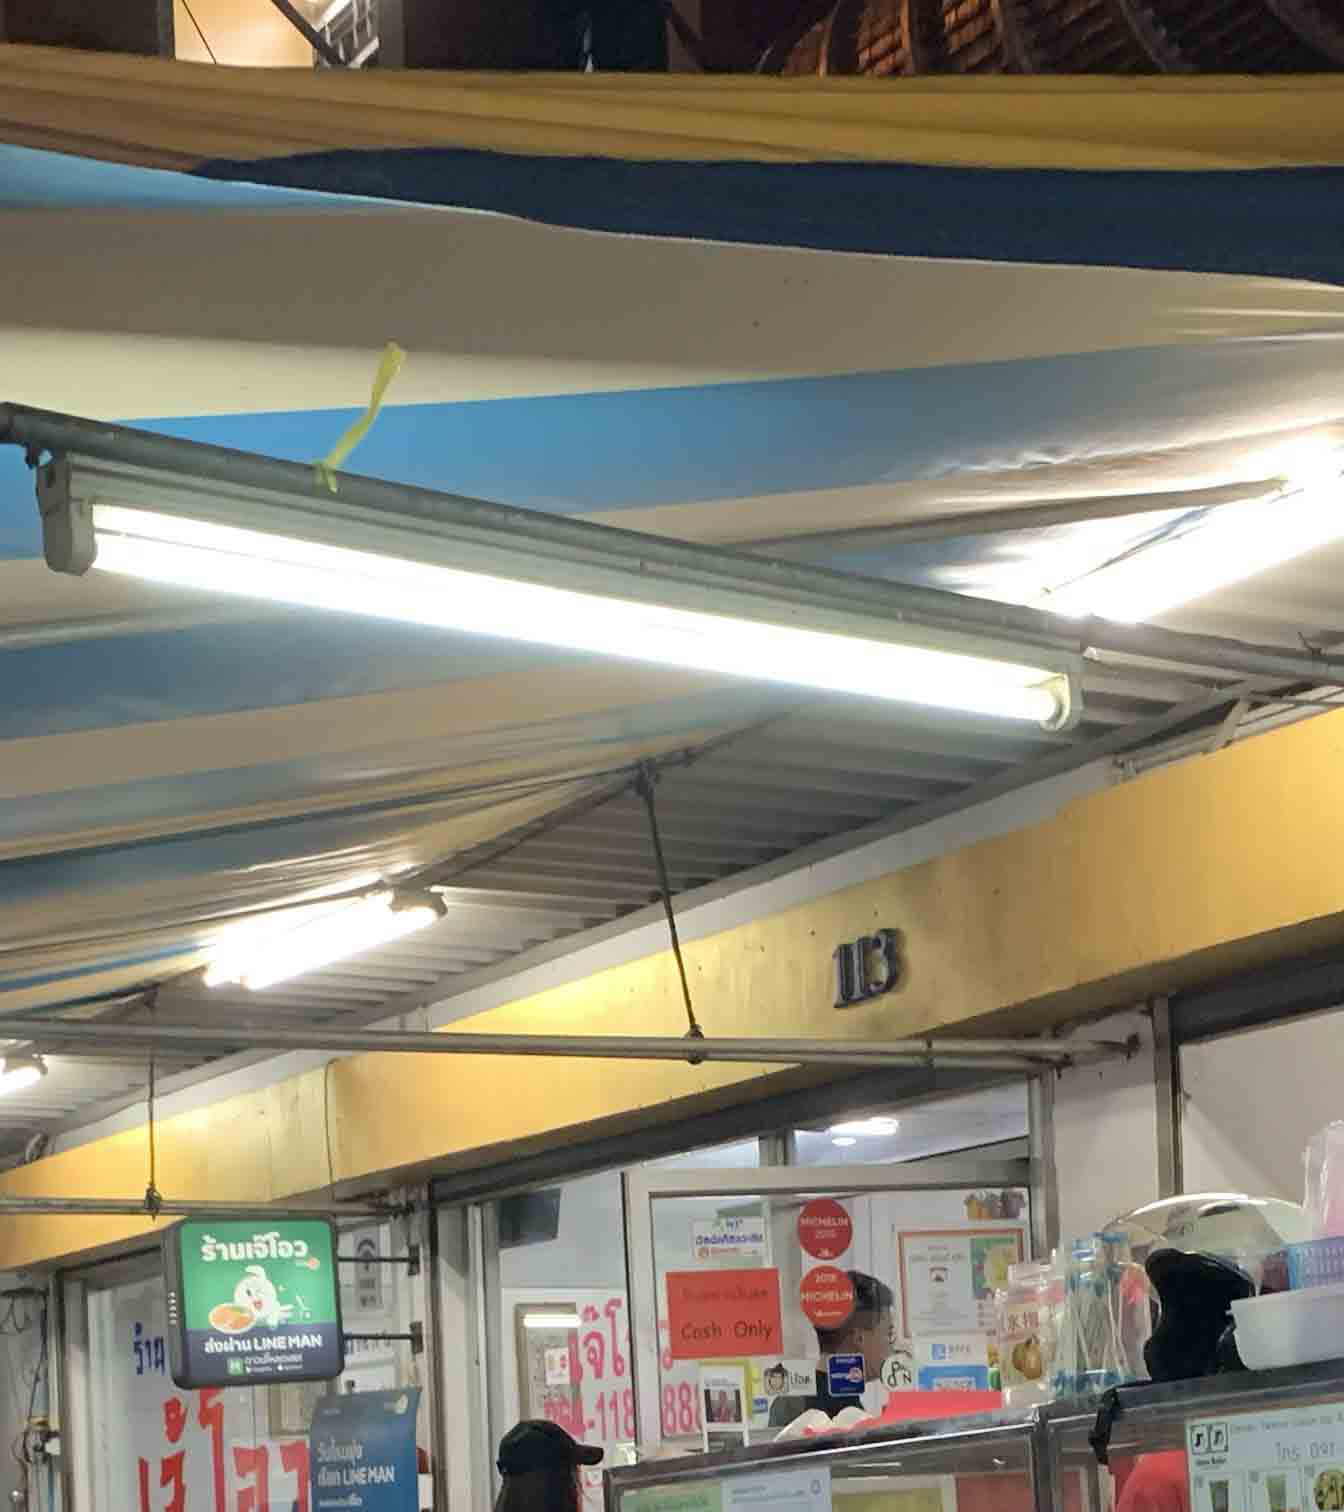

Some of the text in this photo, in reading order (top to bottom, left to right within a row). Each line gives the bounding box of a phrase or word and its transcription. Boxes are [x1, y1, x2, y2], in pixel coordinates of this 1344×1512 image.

[832, 927, 899, 1008] 113
[681, 1320, 773, 1341] Cash Only
[254, 1335, 287, 1351] LINE
[288, 1333, 323, 1349] MAN
[367, 1464, 396, 1484] MAN
